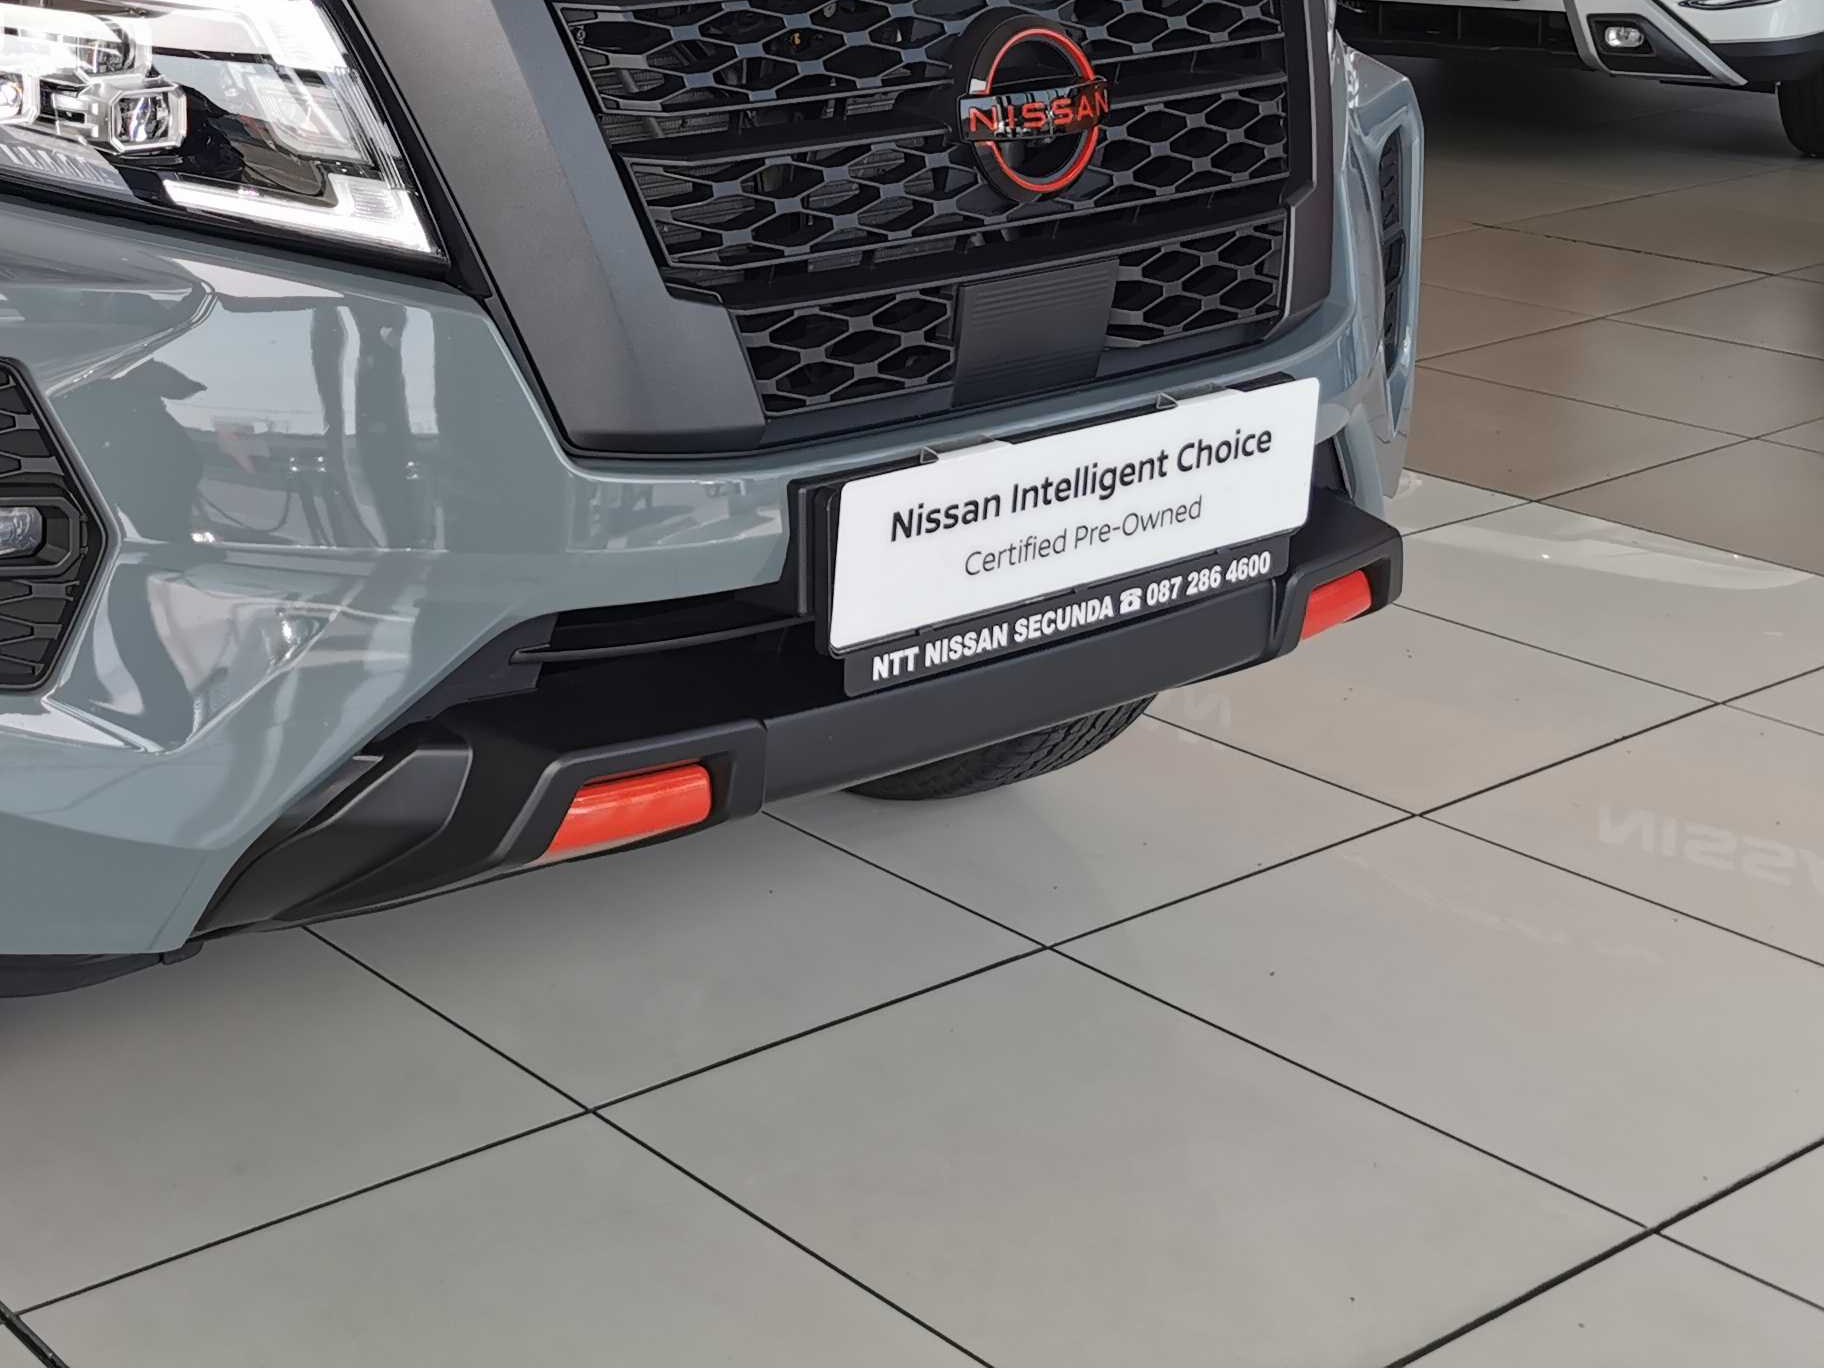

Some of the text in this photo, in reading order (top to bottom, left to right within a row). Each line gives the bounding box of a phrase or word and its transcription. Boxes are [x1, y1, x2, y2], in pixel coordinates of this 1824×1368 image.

[969, 89, 1110, 132] NISSAN
[890, 429, 1273, 543] Nissan Intelligent Choice
[964, 494, 1203, 577] Certified Pre-Owned
[872, 549, 1272, 682] NTT NISSAN SECUNDA 087 286 4600
